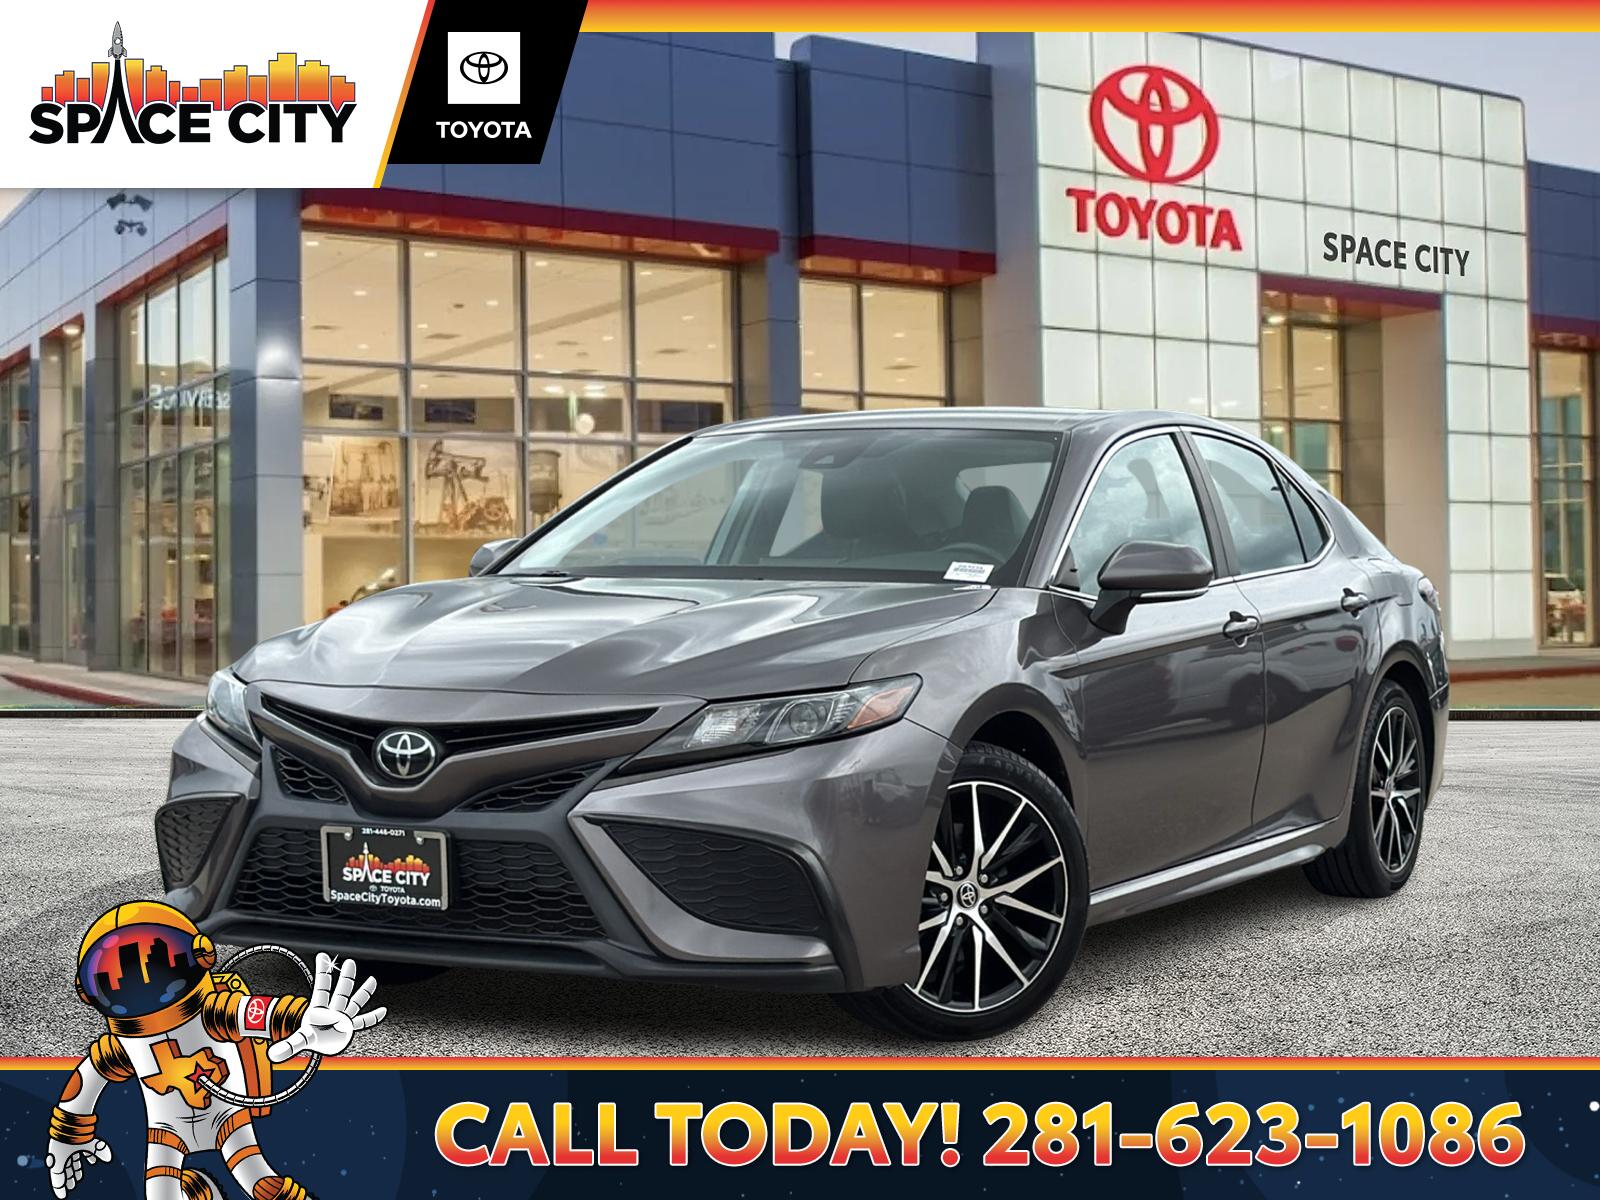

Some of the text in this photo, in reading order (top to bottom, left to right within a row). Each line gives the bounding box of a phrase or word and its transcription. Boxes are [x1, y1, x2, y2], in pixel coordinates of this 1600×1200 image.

[1066, 188, 1242, 251] TOYOTA
[1323, 232, 1470, 277] SPACE CITY
[342, 860, 431, 887] SPACE CITY
[330, 890, 441, 907] SpaceCityToyota.com
[380, 886, 405, 894] TOYOTA
